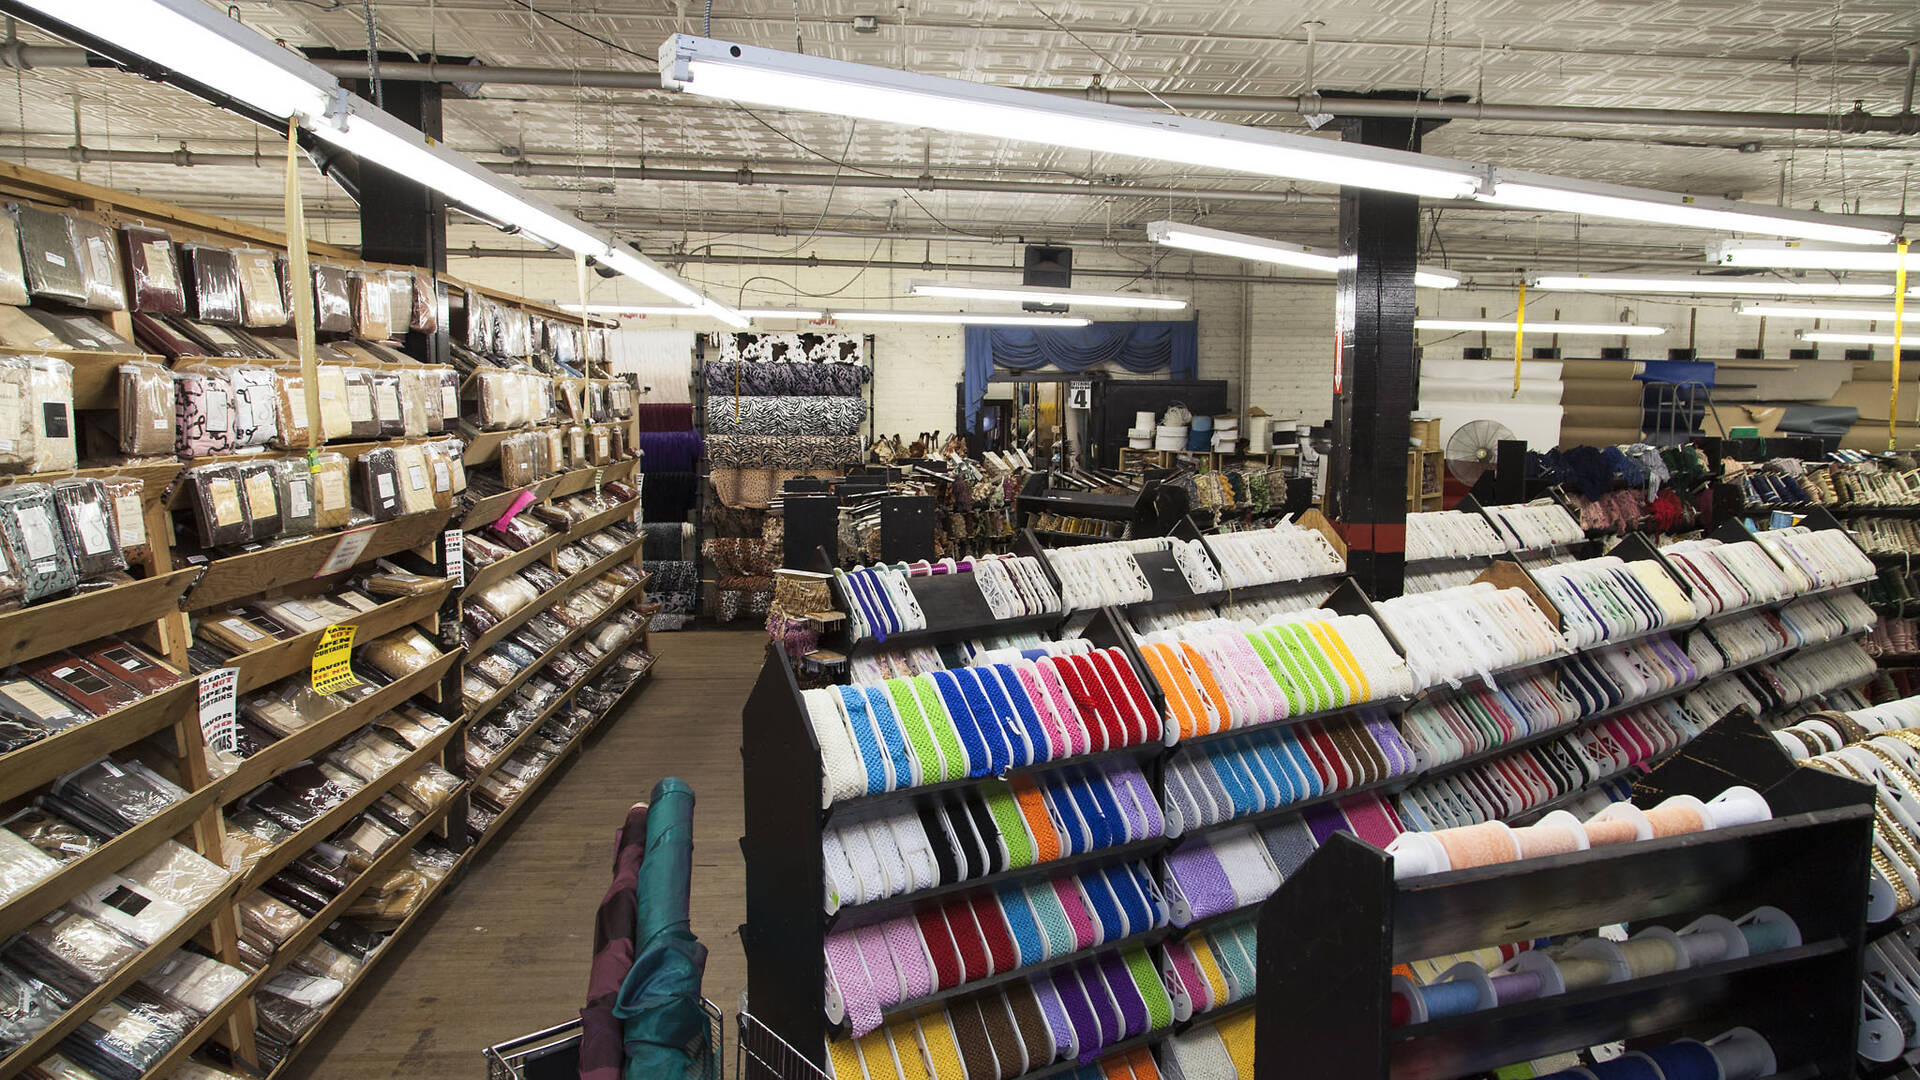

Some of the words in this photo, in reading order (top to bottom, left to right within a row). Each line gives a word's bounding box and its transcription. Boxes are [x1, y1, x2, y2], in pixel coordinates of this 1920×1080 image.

[1074, 390, 1087, 407] 4
[317, 637, 350, 650] OPEN
[314, 660, 348, 674] FAVOR
[212, 677, 234, 688] NOT
[200, 685, 233, 702] OPEN
